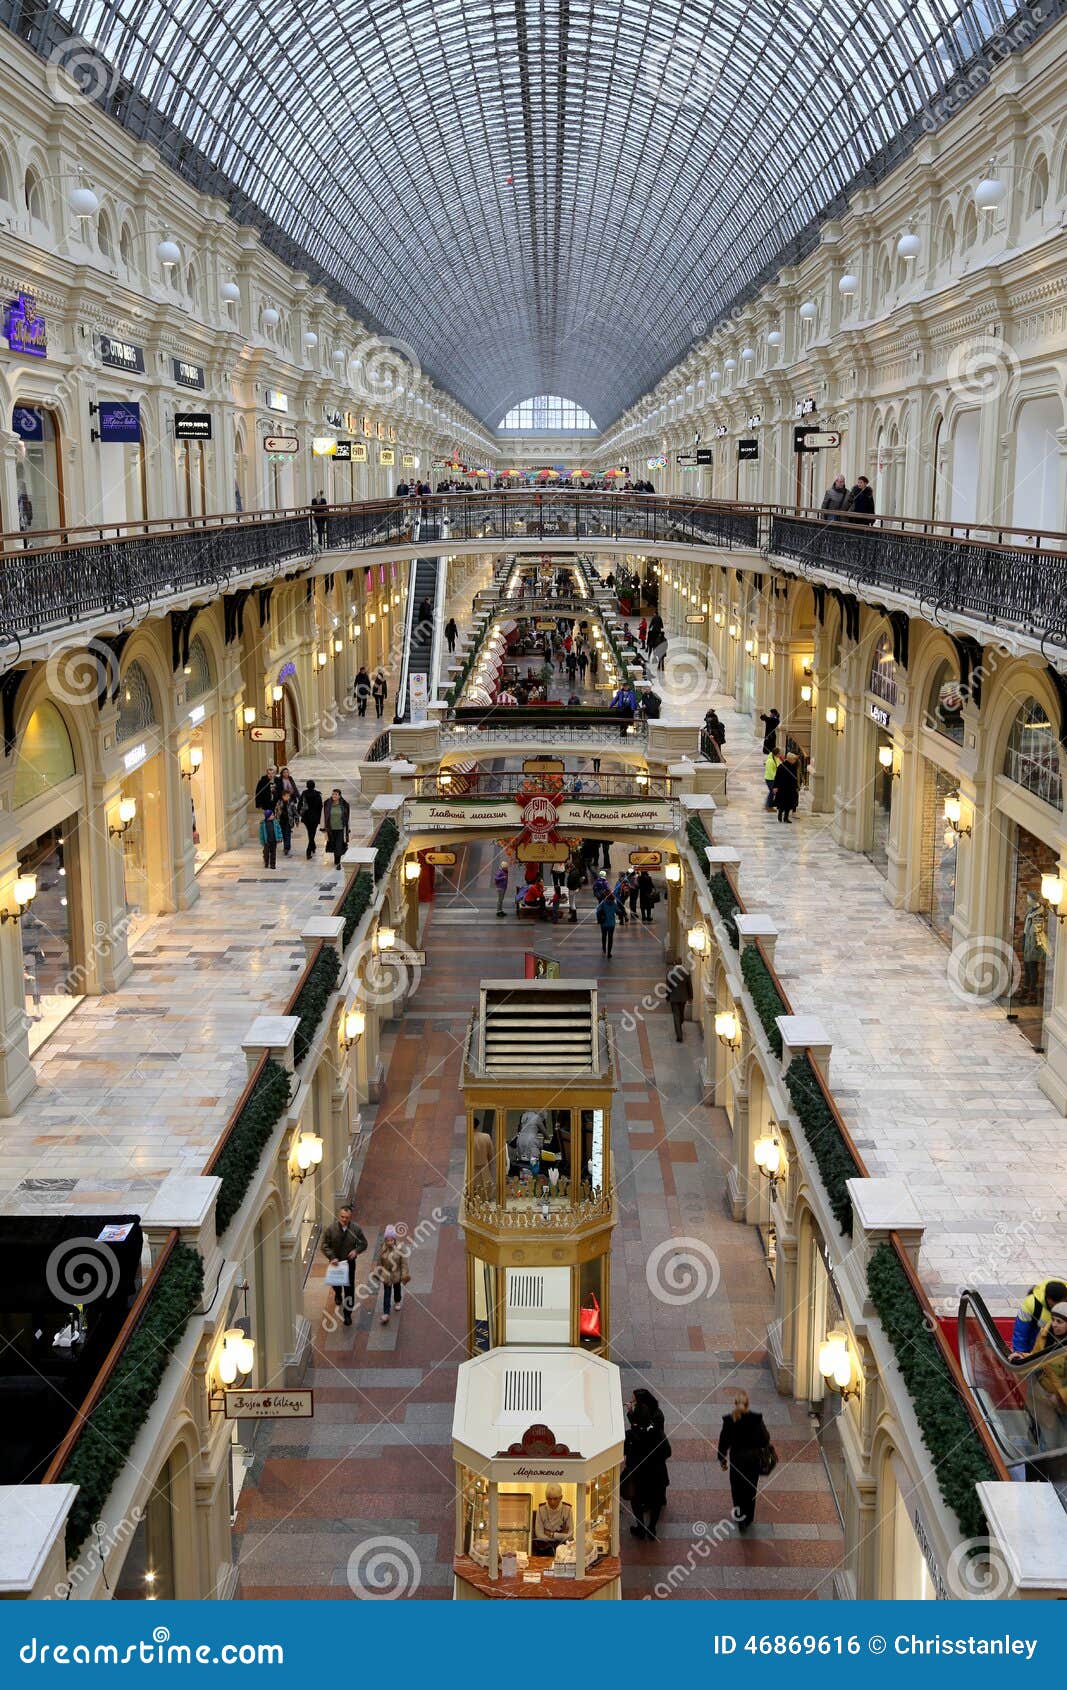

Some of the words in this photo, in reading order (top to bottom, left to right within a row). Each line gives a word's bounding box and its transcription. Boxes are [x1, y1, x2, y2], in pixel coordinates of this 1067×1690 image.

[110, 340, 124, 359] OTTO
[123, 344, 137, 362] BERG
[429, 807, 465, 819] Главный
[470, 811, 507, 819] магазин
[582, 809, 619, 820] Красной
[621, 811, 658, 819] площади
[513, 1467, 564, 1478] Мороженое
